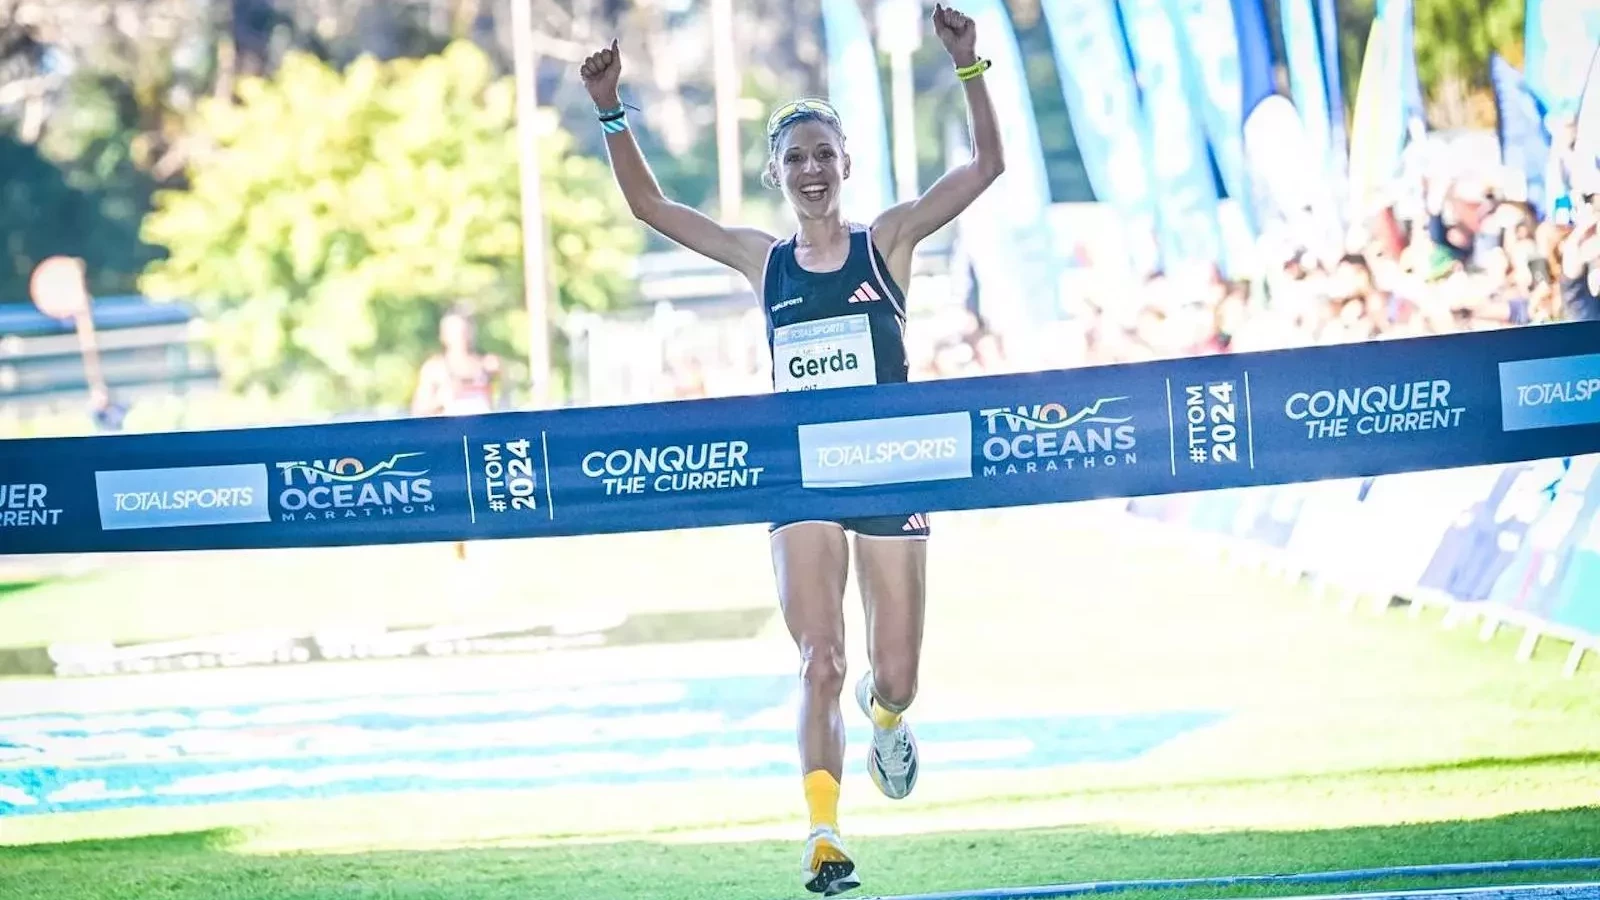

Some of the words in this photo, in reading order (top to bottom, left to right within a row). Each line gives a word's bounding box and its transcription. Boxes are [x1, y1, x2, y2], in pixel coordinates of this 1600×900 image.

[789, 349, 858, 378] Gerda
[1285, 379, 1450, 420] CONQUER
[1517, 378, 1600, 407] TOTALSP
[979, 403, 1068, 434] TWO
[1187, 385, 1207, 462] #TTOM
[1210, 382, 1237, 462] 2024
[1305, 418, 1348, 439] THE
[1356, 407, 1466, 435] CURRENT
[582, 441, 748, 477] CONQUER
[817, 437, 957, 468] TOTALSPORTS
[982, 425, 1137, 462] OCEANS
[276, 458, 364, 486] TWO
[484, 443, 507, 512] #TTOM
[507, 439, 536, 510] 2024
[983, 452, 1137, 477] MARATHON
[280, 478, 433, 510] OCEANS
[601, 476, 646, 496] THE
[655, 468, 764, 491] CURRENT
[113, 487, 252, 511] TOTALSPORTS
[282, 503, 435, 521] MARATHON
[0, 508, 63, 527] RENT
